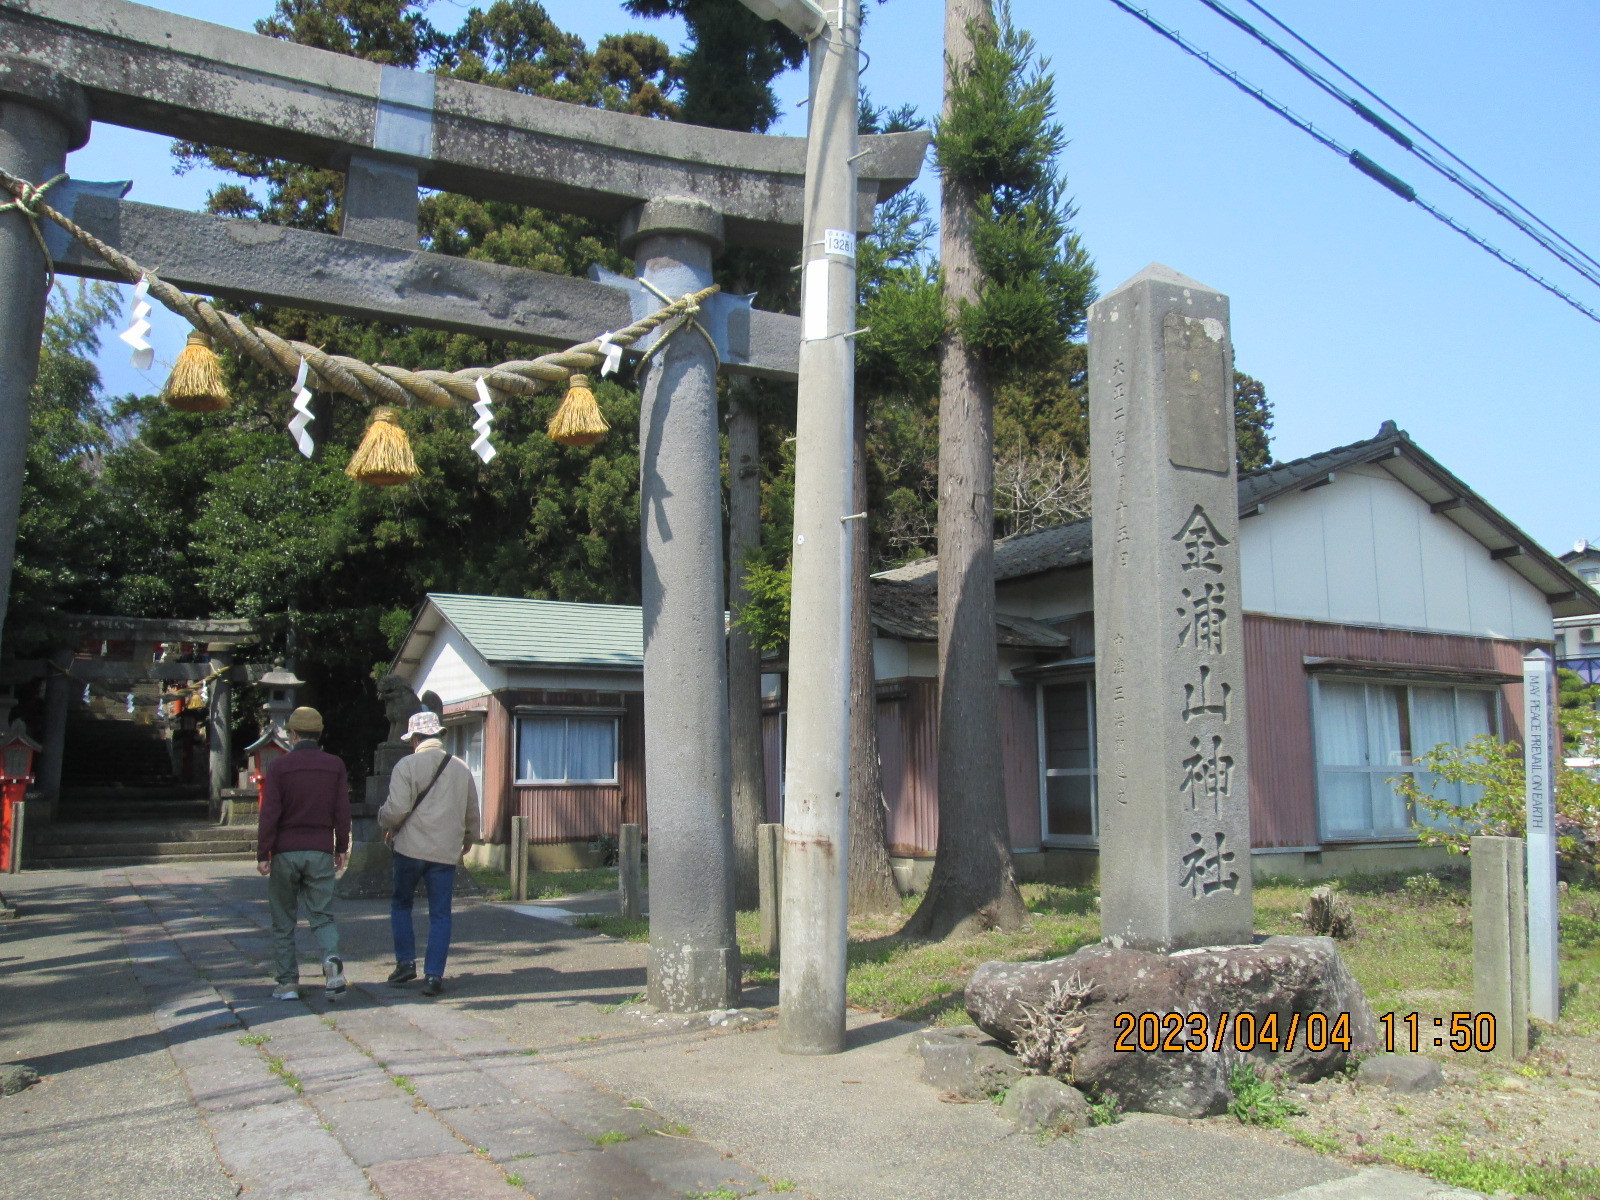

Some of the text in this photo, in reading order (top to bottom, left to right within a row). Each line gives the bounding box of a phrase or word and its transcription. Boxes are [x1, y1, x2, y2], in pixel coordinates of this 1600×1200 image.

[1171, 503, 1240, 899] 金浦山神社
[1529, 675, 1544, 829] MAY PEACE PREVAIL ON EARTH
